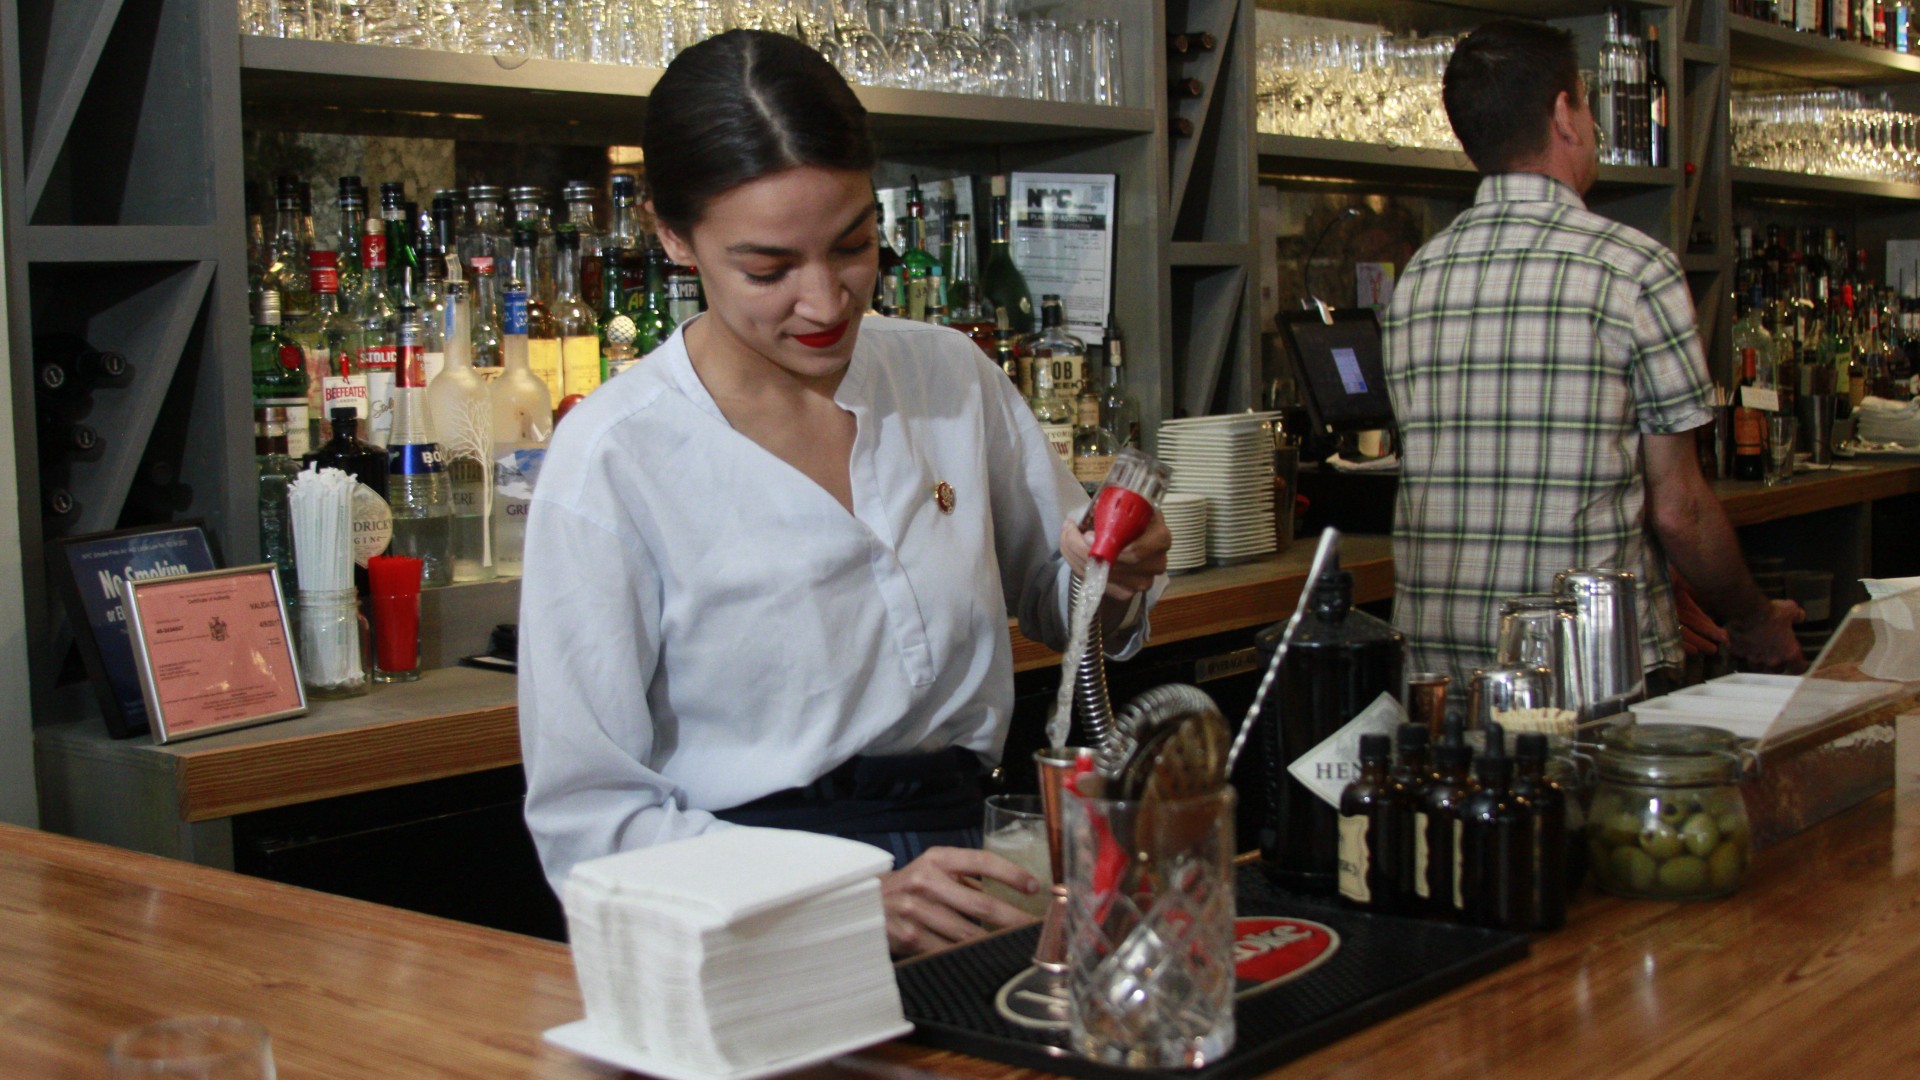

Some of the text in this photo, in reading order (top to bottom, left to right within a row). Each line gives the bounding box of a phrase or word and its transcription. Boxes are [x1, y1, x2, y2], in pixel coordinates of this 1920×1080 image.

[1027, 188, 1072, 208] NYC
[326, 386, 367, 401] BEEFEATER
[422, 451, 443, 464] BO
[98, 570, 122, 599] No
